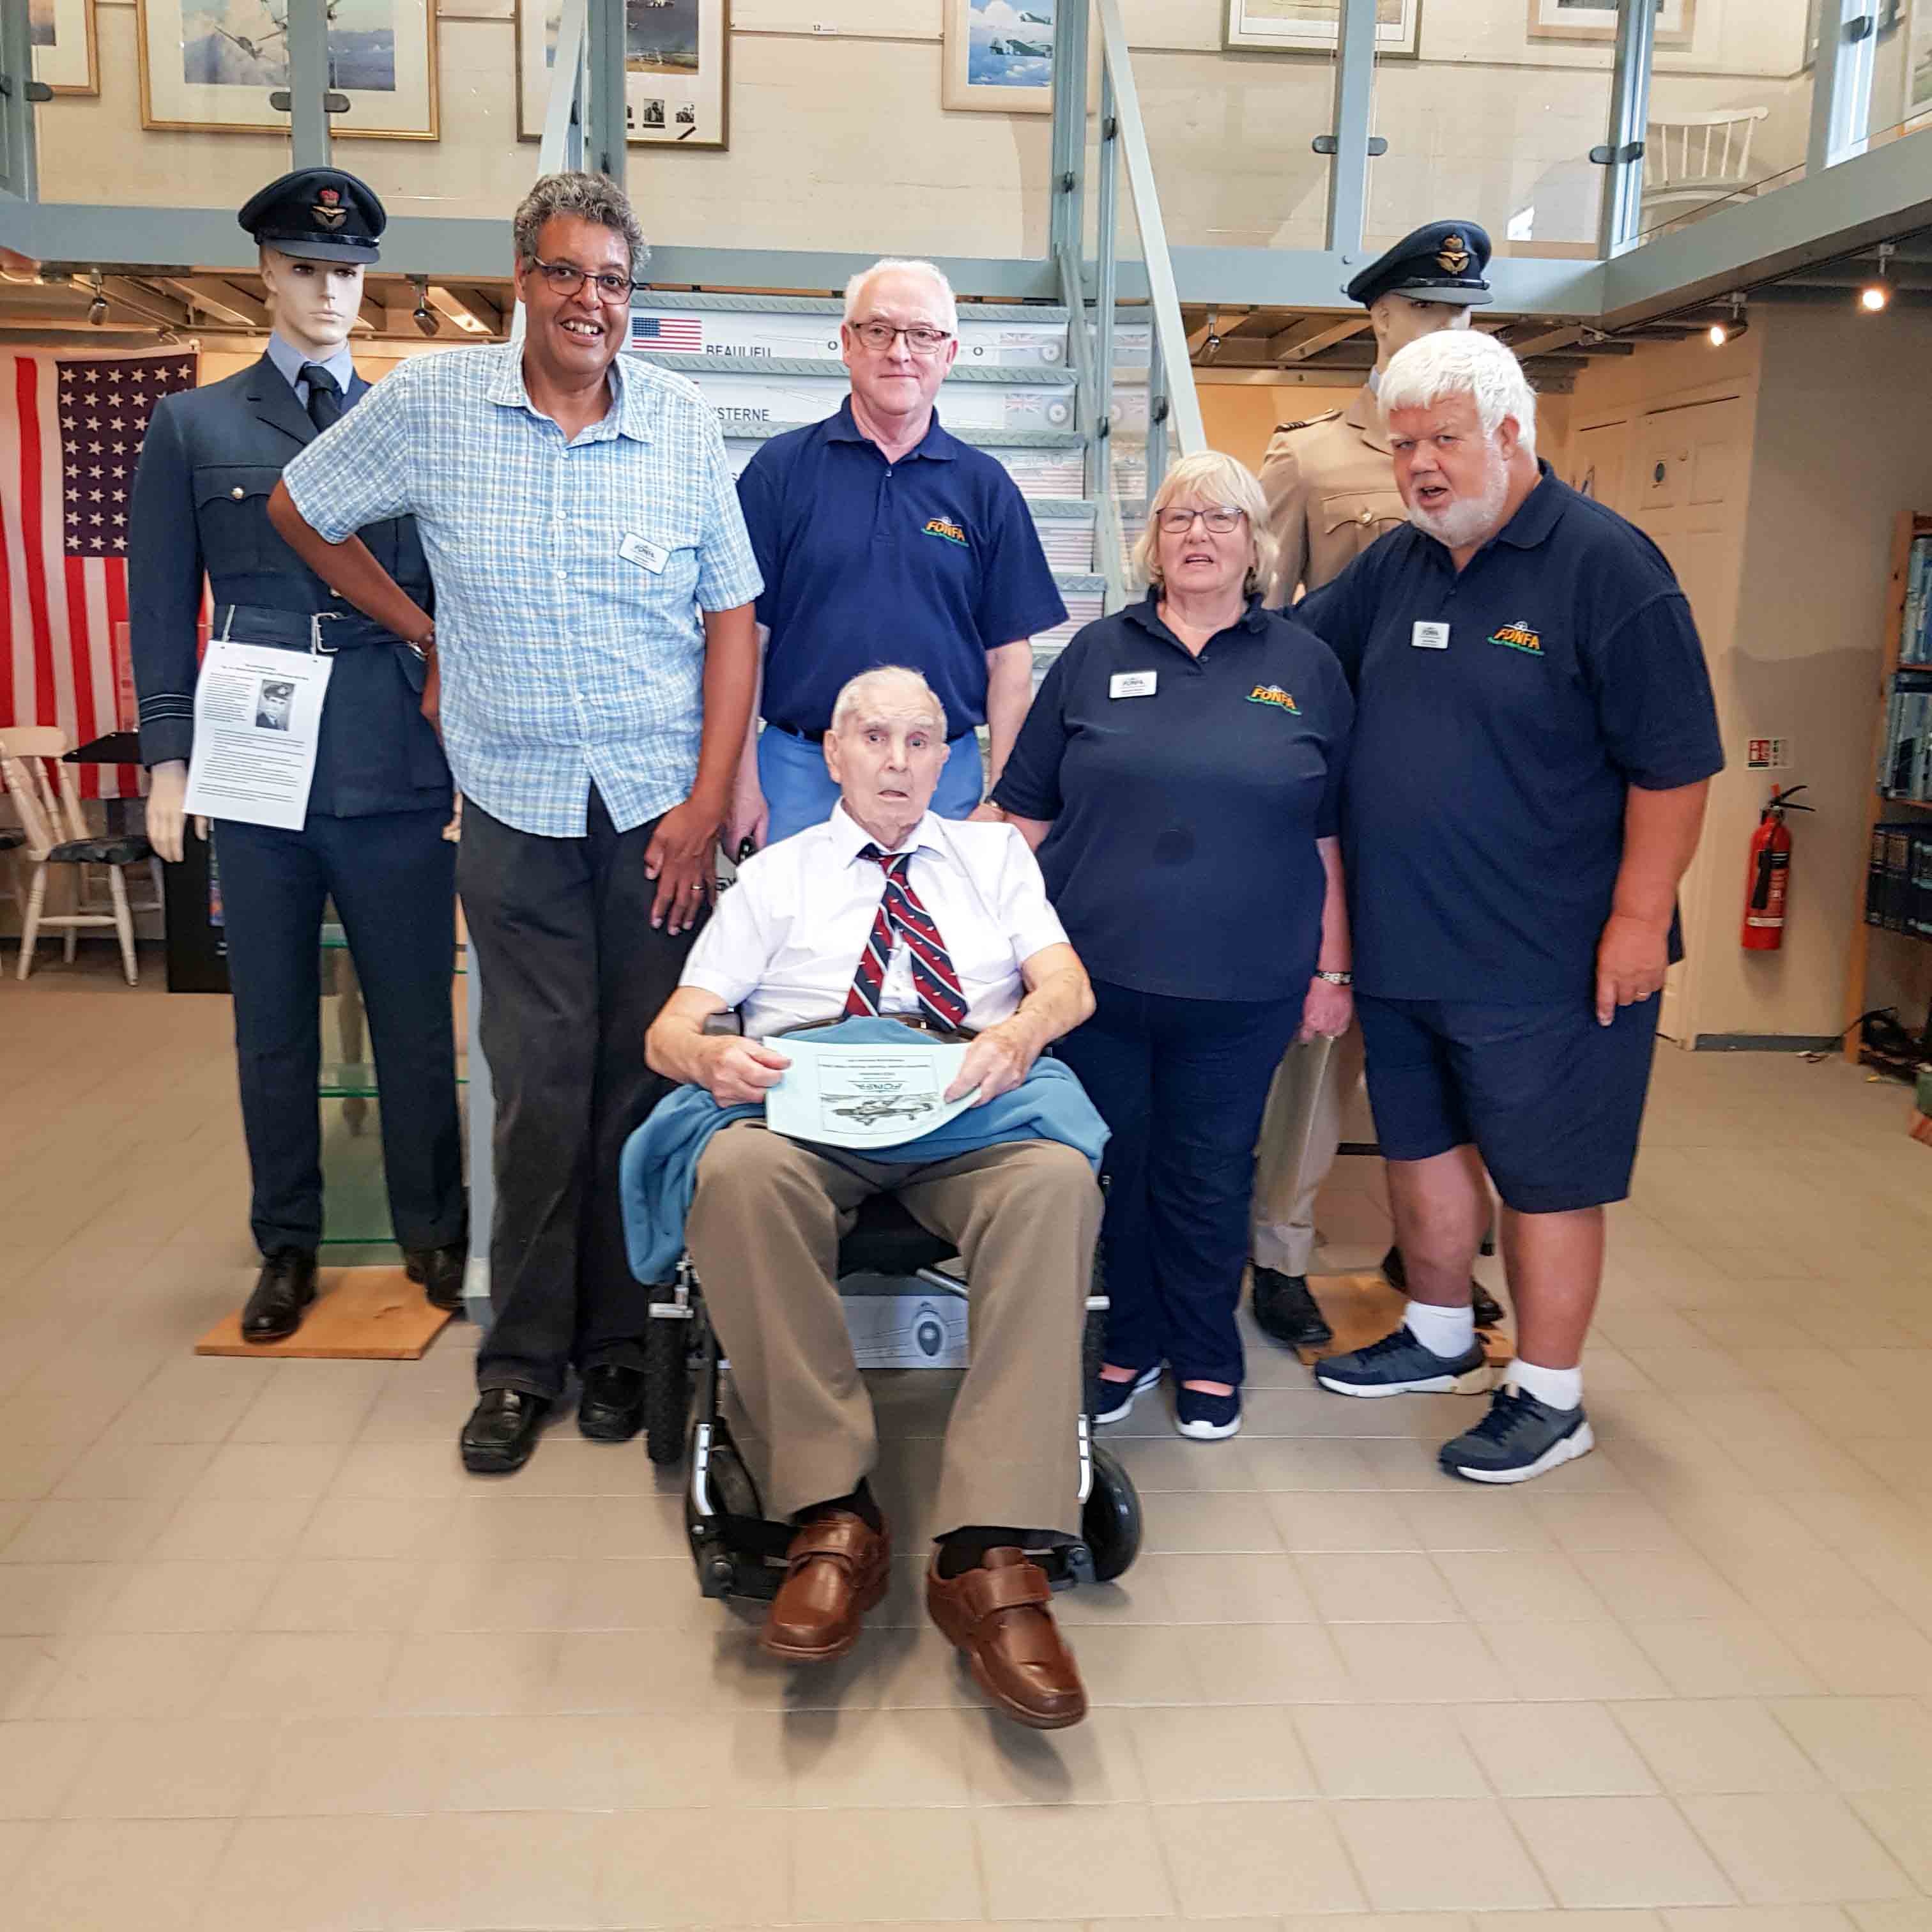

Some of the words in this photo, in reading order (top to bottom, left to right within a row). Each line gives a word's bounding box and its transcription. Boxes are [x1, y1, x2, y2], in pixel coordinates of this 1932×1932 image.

[706, 345, 770, 358] BEAULIEU
[714, 407, 770, 422] STERNE
[1494, 628, 1540, 650] FONFA
[1251, 687, 1297, 710] FONFA
